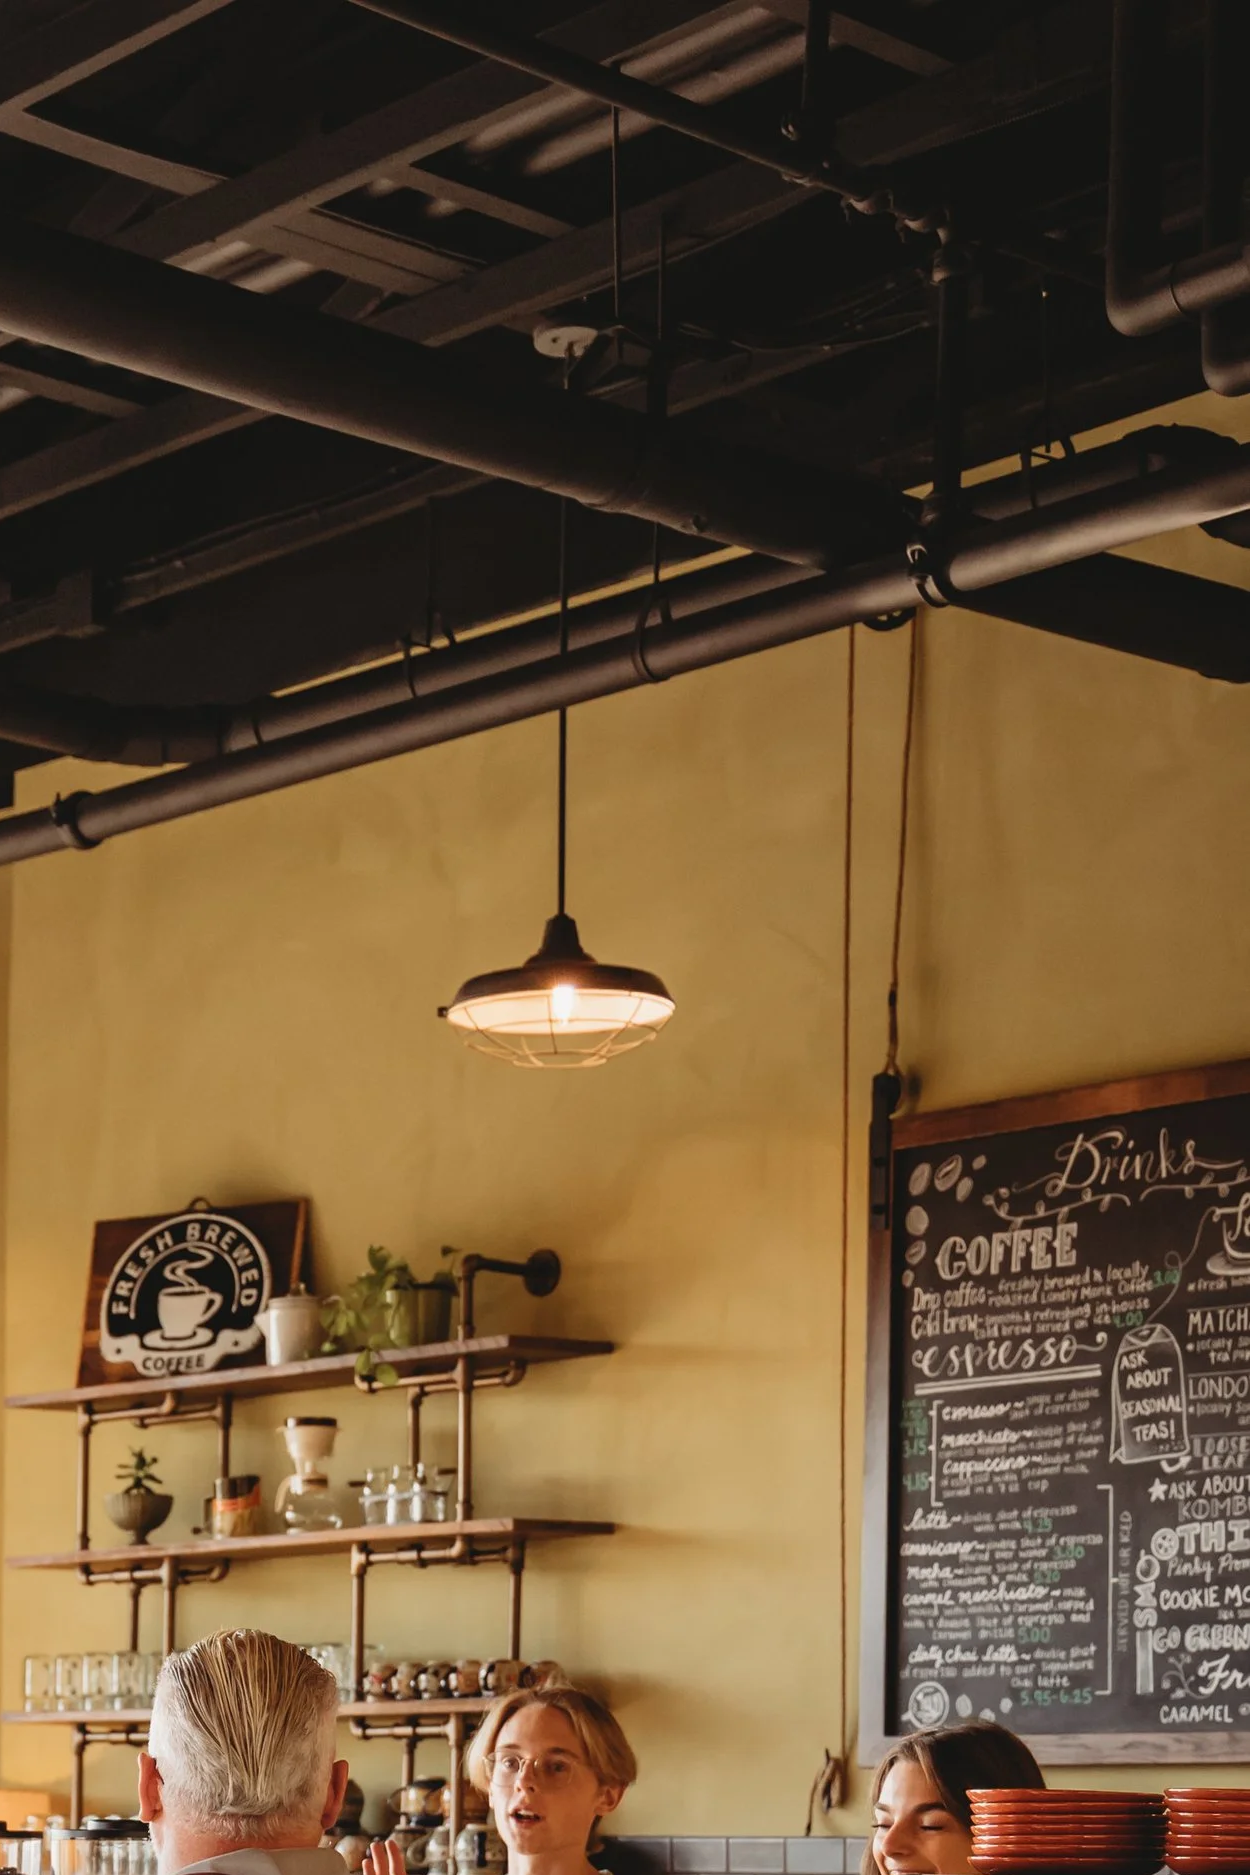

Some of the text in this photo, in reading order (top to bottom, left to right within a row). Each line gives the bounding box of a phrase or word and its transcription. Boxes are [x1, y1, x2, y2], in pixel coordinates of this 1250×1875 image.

[1013, 1126, 1244, 1197] Drinks
[935, 1221, 1078, 1280] COFFEE
[111, 1222, 260, 1315] FRESH BREWED
[1043, 1266, 1090, 1290] brewed
[1106, 1260, 1149, 1282] locally
[912, 1286, 941, 1315] Drip
[911, 1310, 940, 1340] Cold
[1187, 1307, 1250, 1336] MATCH
[142, 1353, 206, 1371] COFFEE
[911, 1331, 1108, 1378] espresso
[1120, 1349, 1149, 1370] ASK
[1126, 1367, 1172, 1390] ABOUT
[1190, 1375, 1250, 1400] LONDO
[1121, 1394, 1183, 1419] SEASONAL
[1131, 1418, 1175, 1442] TEAS!
[1193, 1435, 1250, 1457] LOOSE
[1168, 1480, 1198, 1500] ASK
[1178, 1494, 1250, 1522] KOMB
[1167, 1555, 1213, 1583] Pinky
[1159, 1585, 1221, 1611] COOKIE
[1153, 1622, 1250, 1654] GO GREEN
[1159, 1704, 1233, 1724] CARAMEL
